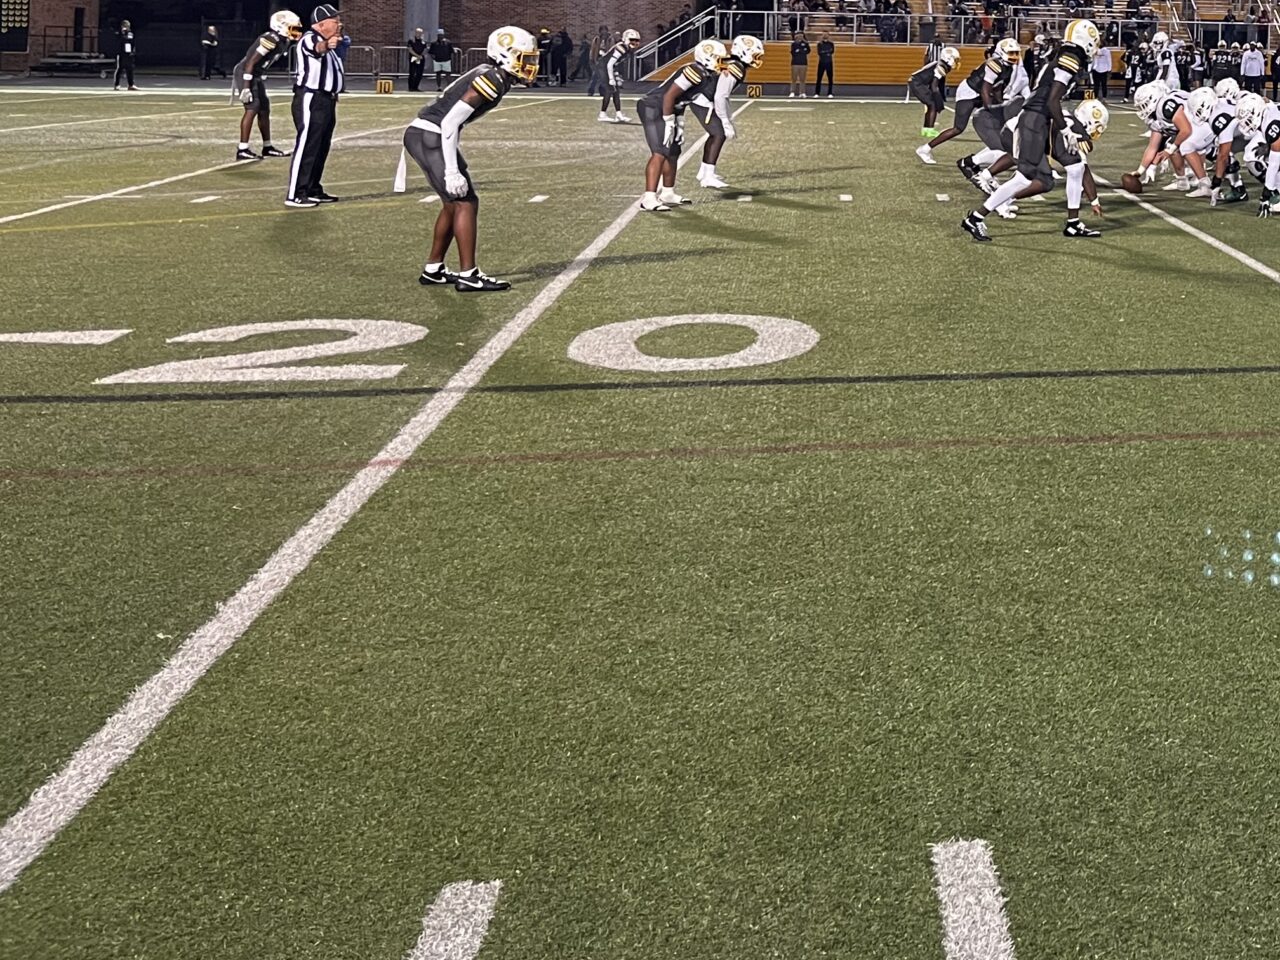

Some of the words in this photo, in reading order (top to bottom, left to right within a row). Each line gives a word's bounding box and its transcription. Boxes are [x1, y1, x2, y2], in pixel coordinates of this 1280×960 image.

[380, 81, 391, 94] 10
[748, 85, 761, 98] 20
[1164, 101, 1177, 113] 70
[1267, 124, 1280, 138] 50
